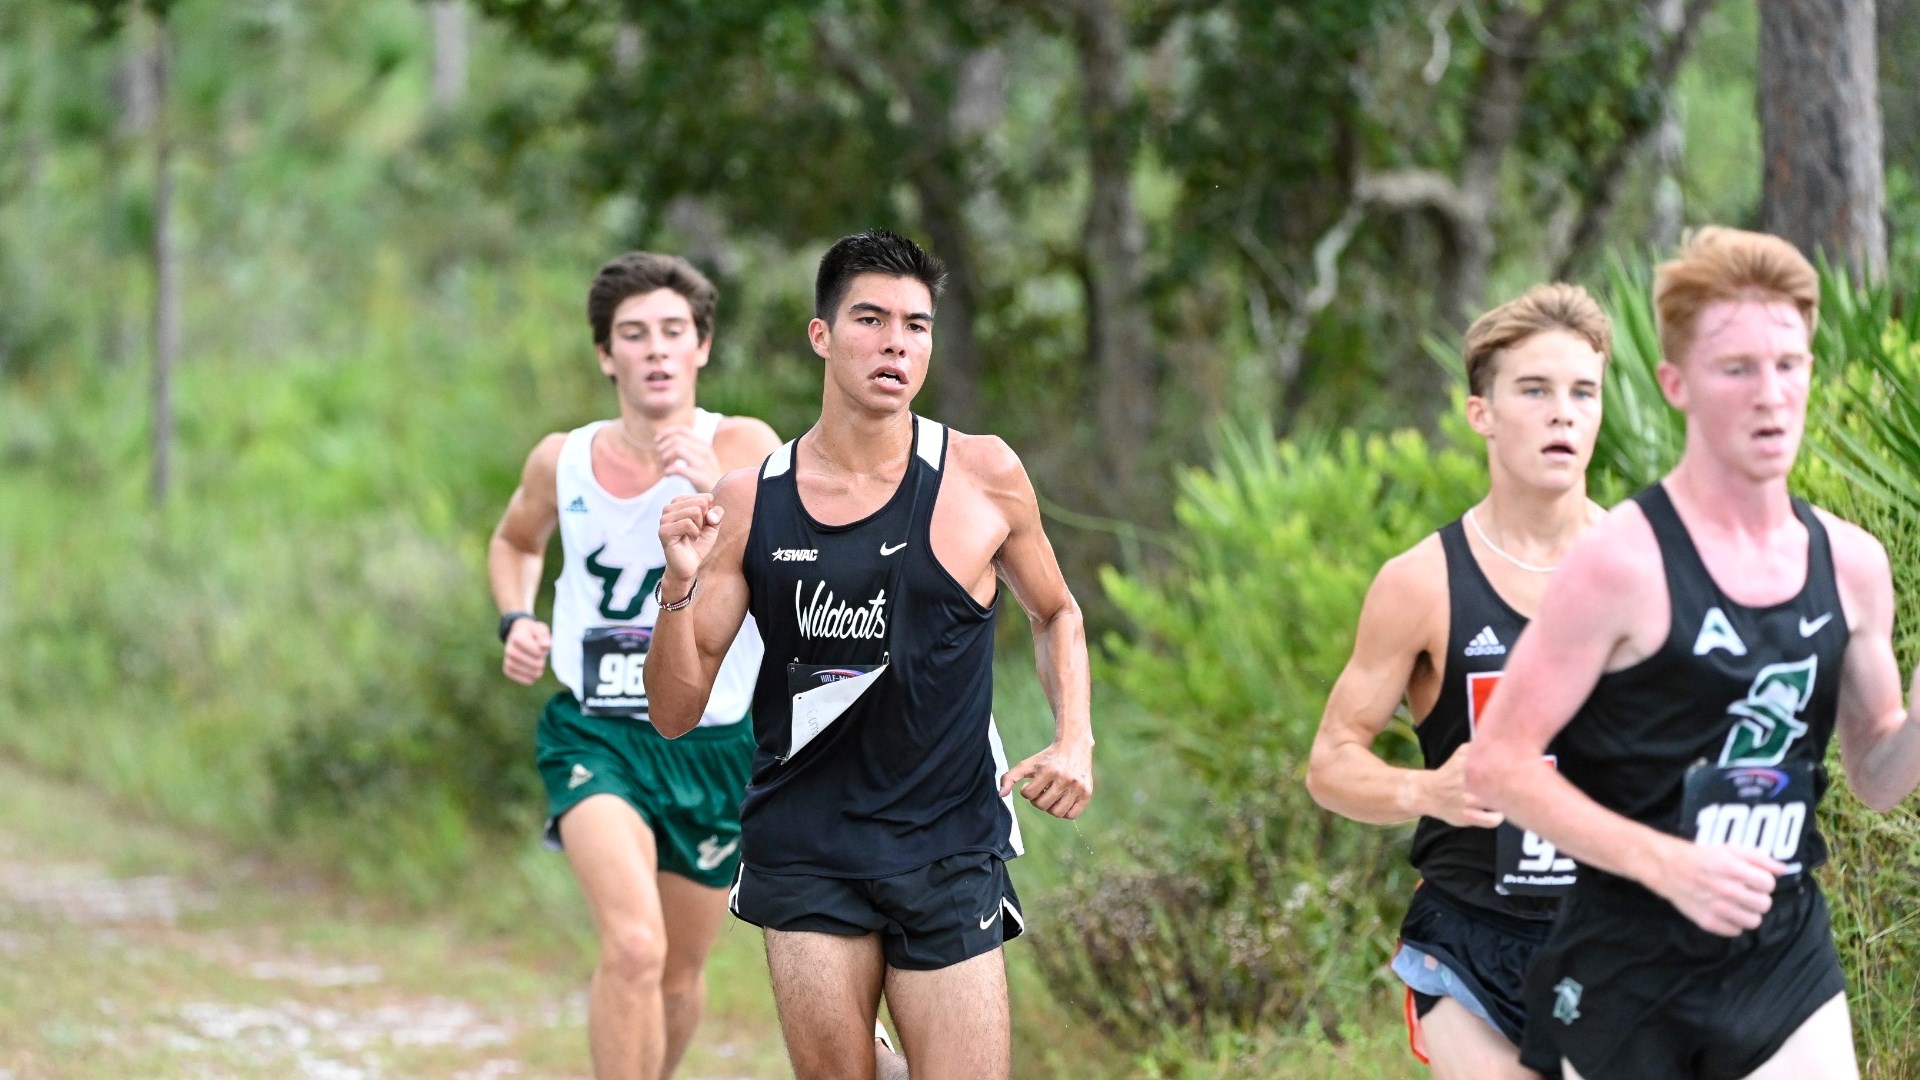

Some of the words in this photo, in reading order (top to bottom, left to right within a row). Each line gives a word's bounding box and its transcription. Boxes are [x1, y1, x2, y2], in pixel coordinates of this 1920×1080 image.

[782, 548, 819, 562] SWAC
[795, 579, 887, 641] Wildcats
[1463, 644, 1506, 657] adidas
[1695, 802, 1806, 861] 1000
